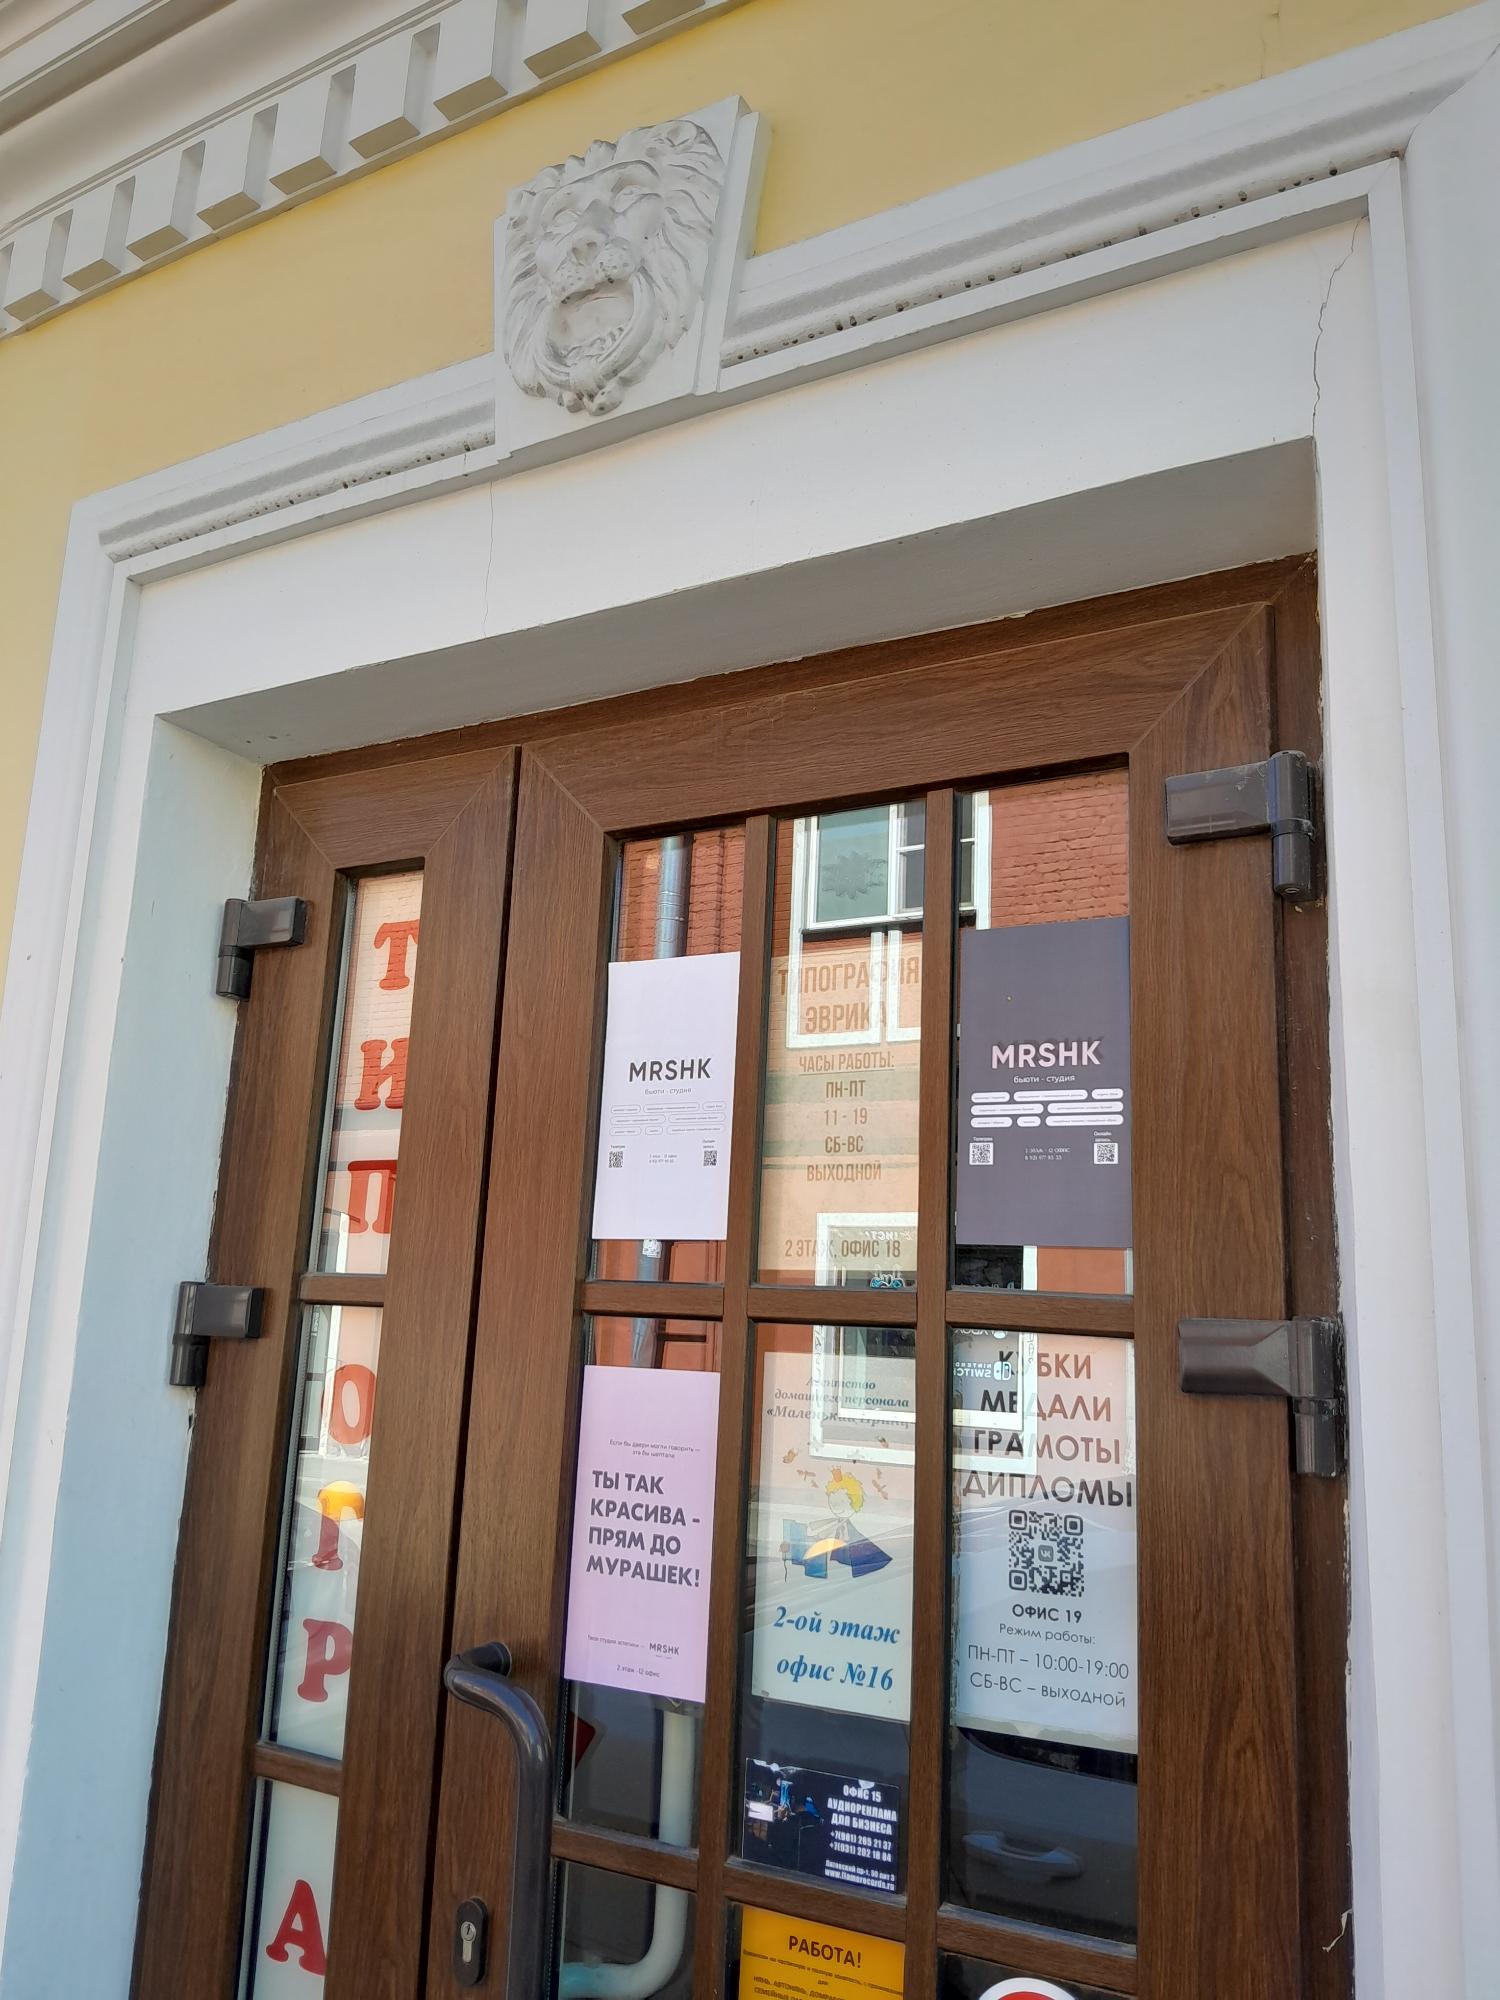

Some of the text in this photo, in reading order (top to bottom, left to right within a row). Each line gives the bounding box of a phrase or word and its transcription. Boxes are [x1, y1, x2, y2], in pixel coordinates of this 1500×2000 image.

[799, 1050, 895, 1072] ЧАСЫ РАБОТЫ:
[992, 1040, 1101, 1069] MRSHK
[628, 1057, 712, 1082] MRSHK
[1046, 1074, 1076, 1085] студия
[825, 1079, 866, 1099] ПН-ПТ
[824, 1135, 864, 1153] СБ-ВС
[806, 1162, 882, 1182] ВЫХОДНОЙ
[785, 1239, 793, 1257] 2
[841, 1238, 880, 1258] ОФИС
[886, 1239, 901, 1258] 18
[591, 1470, 664, 1495] ТЫ ТАК
[962, 1470, 1133, 1507] ДИПЛОМЫ
[590, 1497, 687, 1527] КРАСИВА
[588, 1526, 682, 1557] ПРЯМ ДО
[586, 1556, 701, 1588] МУРАШЕК!
[773, 1605, 901, 1645] 2-ой этаж
[1012, 1603, 1083, 1624] ОФИС 19
[999, 1623, 1096, 1647] Режим работы:
[649, 1642, 680, 1656] MRSHK
[776, 1654, 894, 1691] офис №16
[968, 1644, 1015, 1666] ПН-ПТ
[1035, 1653, 1129, 1680] 10:00-19:00
[970, 1672, 1022, 1693] СБ-ВС
[843, 1784, 870, 1800] ОФИС
[852, 1816, 893, 1836] БИЗНЕСА
[788, 1935, 862, 1969] РАБОТА!
